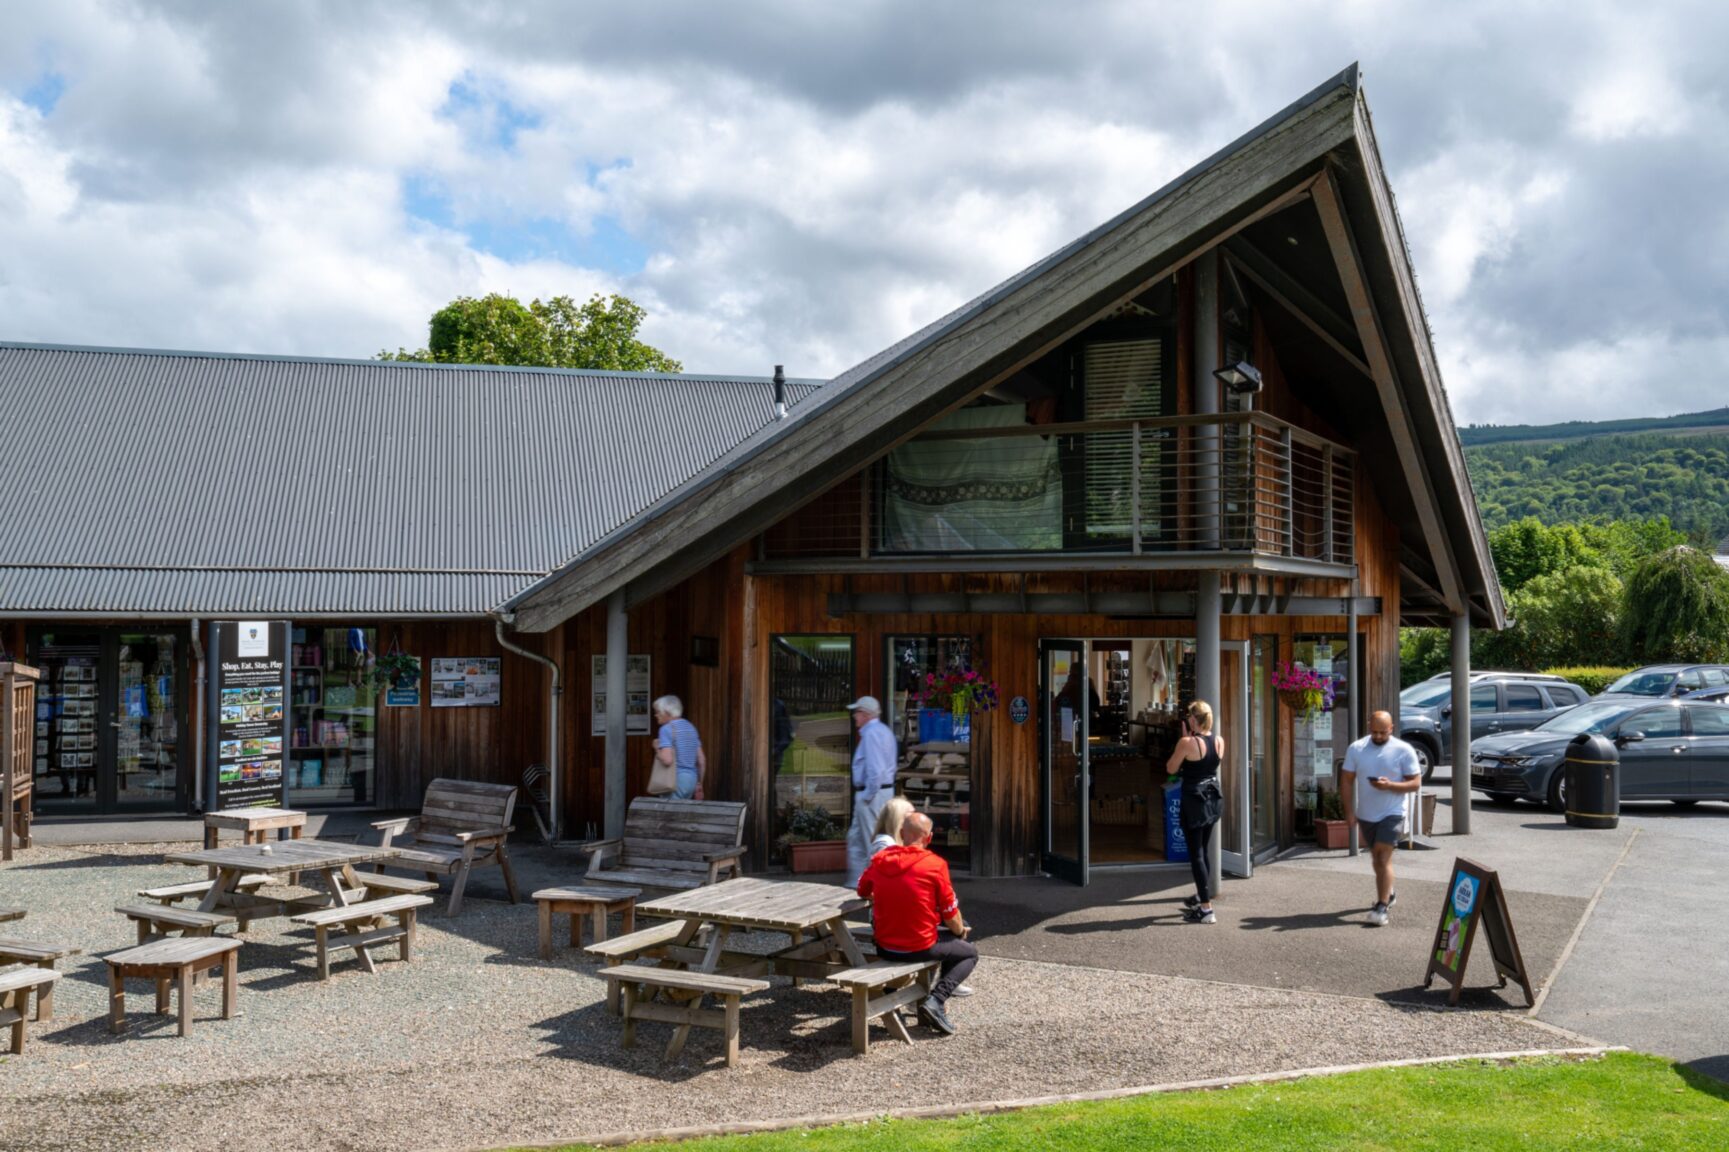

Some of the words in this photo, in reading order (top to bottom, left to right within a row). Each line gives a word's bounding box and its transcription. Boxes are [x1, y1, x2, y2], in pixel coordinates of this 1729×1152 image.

[222, 662, 240, 671] Shop,
[241, 662, 253, 670] Eat,
[255, 661, 269, 670] Stay,
[270, 660, 283, 669] Play
